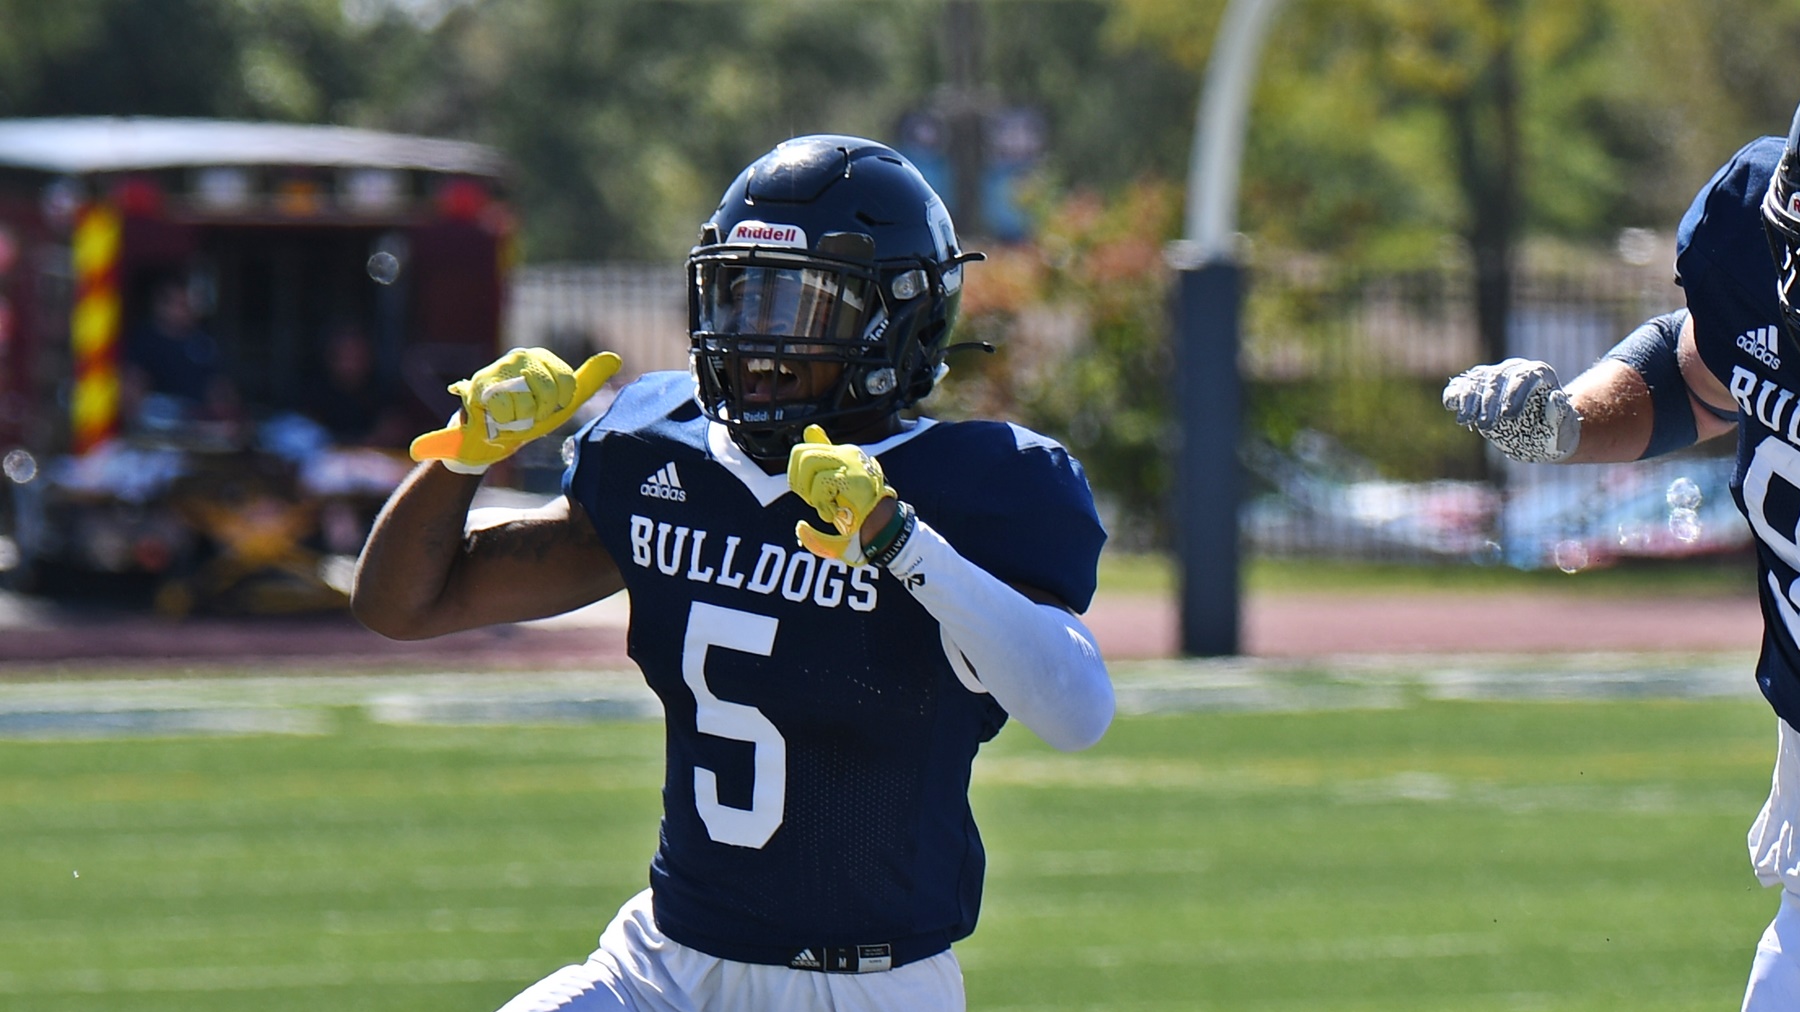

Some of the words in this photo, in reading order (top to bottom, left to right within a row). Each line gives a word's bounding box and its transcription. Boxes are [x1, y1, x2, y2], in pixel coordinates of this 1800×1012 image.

[737, 226, 796, 243] Riddell
[1736, 334, 1782, 371] adidas
[743, 408, 784, 423] Riddll
[640, 481, 687, 502] adidas
[630, 514, 880, 613] BULLDOGS
[681, 600, 787, 850] 5
